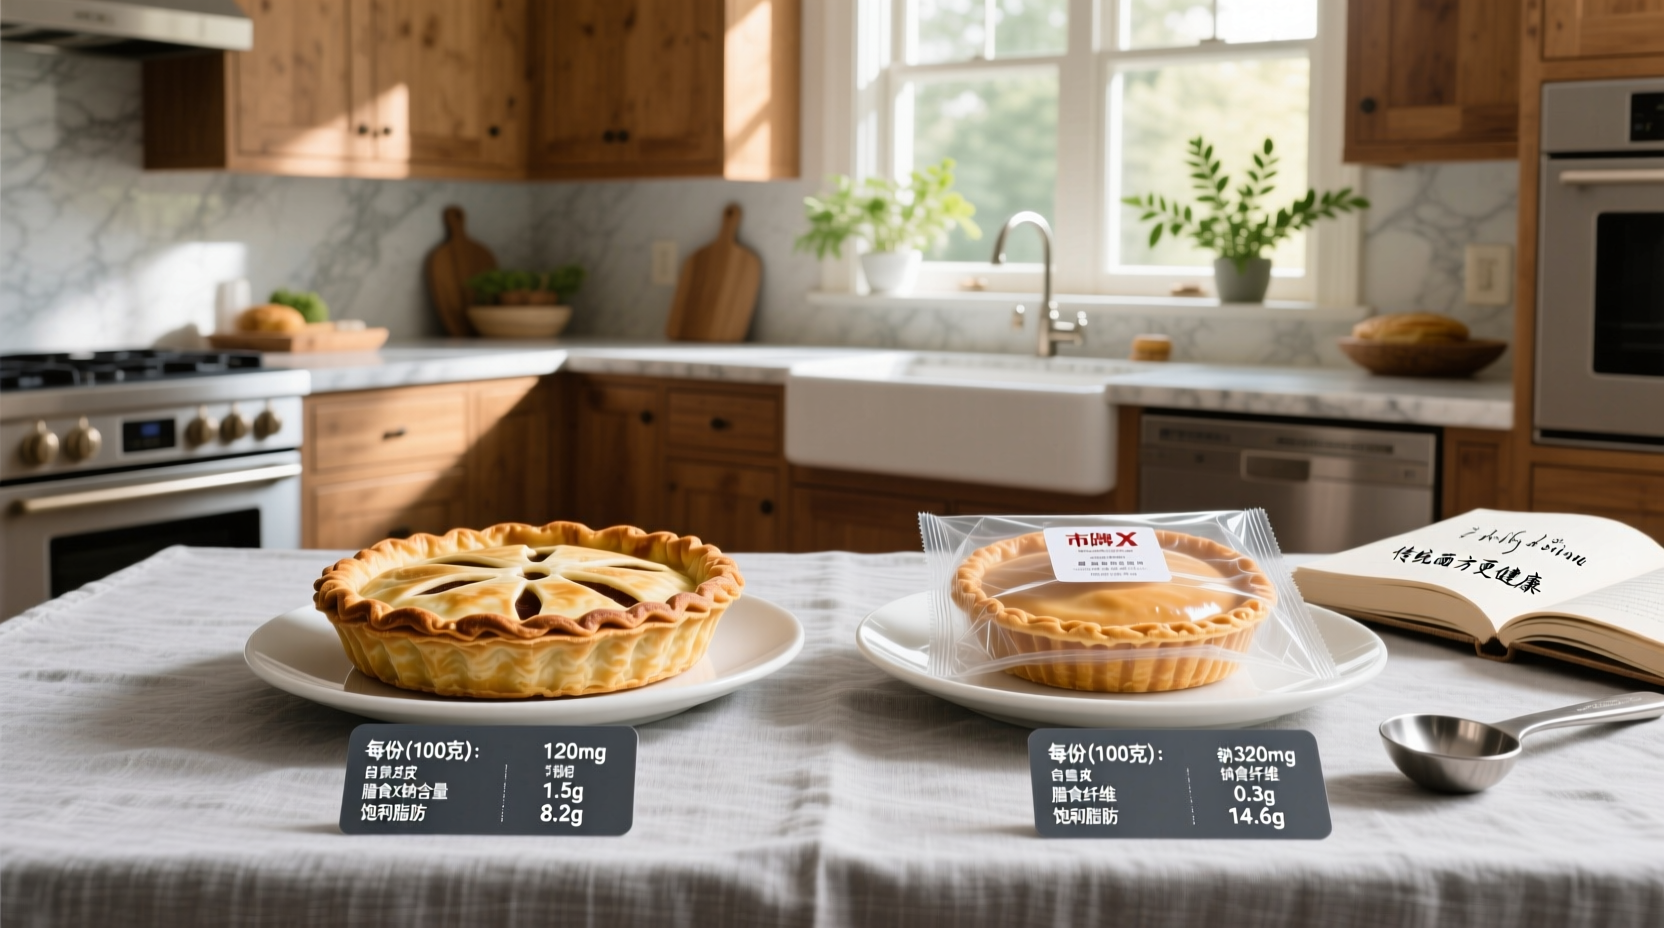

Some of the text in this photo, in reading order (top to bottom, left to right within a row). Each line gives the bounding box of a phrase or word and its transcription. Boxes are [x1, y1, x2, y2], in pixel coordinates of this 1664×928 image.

[543, 742, 607, 765] 120mg
[543, 781, 584, 804] 1.5g
[1233, 784, 1276, 807] 0.3g
[539, 803, 584, 828] 8.2g
[1228, 806, 1286, 829] 14.6g
